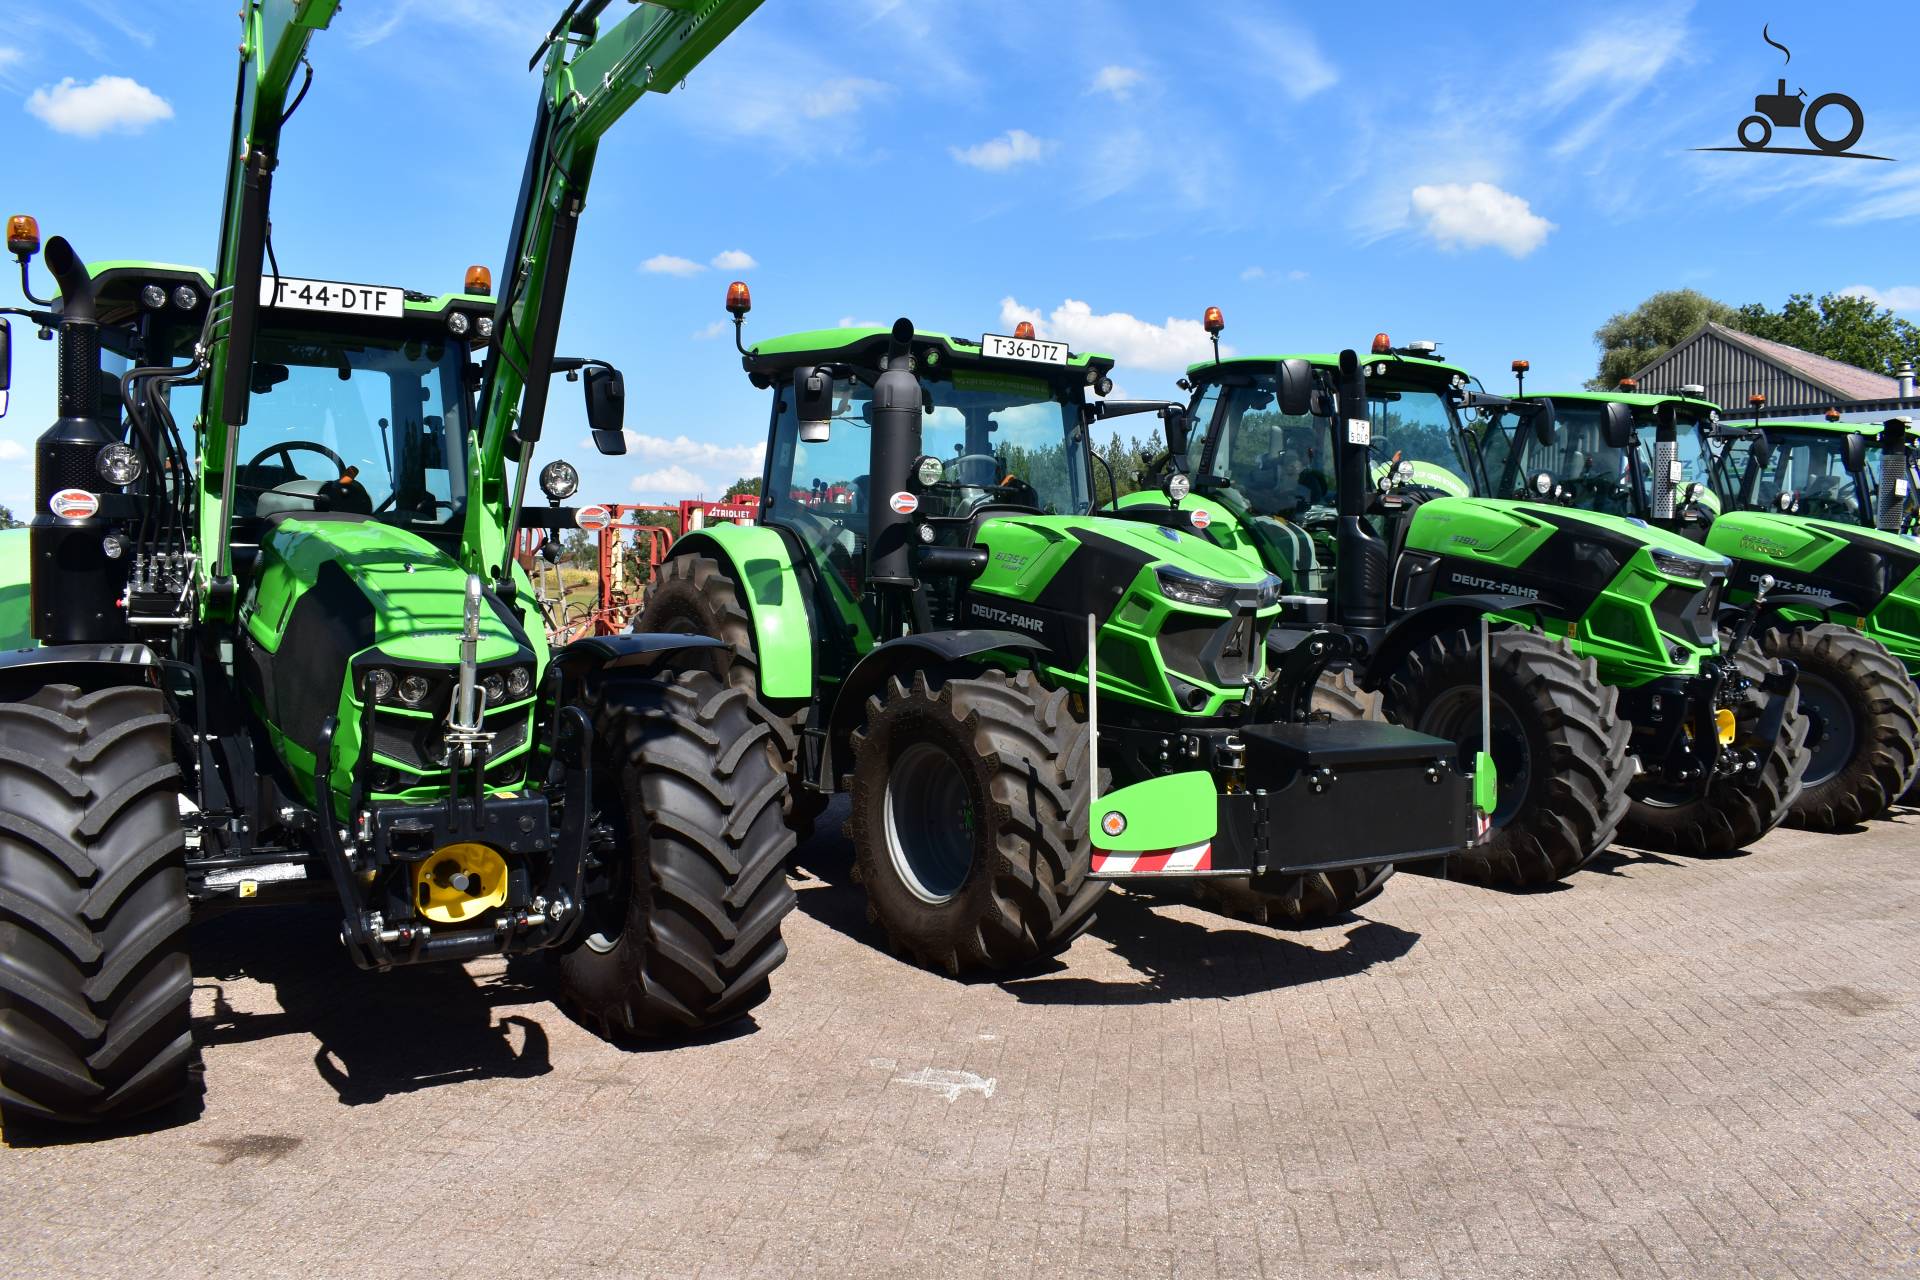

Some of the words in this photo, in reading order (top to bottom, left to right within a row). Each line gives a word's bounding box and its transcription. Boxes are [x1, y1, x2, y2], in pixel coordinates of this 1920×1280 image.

[278, 281, 388, 311] T-44-DTF
[993, 339, 1058, 361] T-36-DTZ
[717, 509, 750, 518] TRIOLIET
[1451, 573, 1539, 600] DEUTZ-FAHR
[1749, 574, 1832, 599] DTZ-FAHR
[971, 603, 1044, 633] DEUTZ-FAHR
